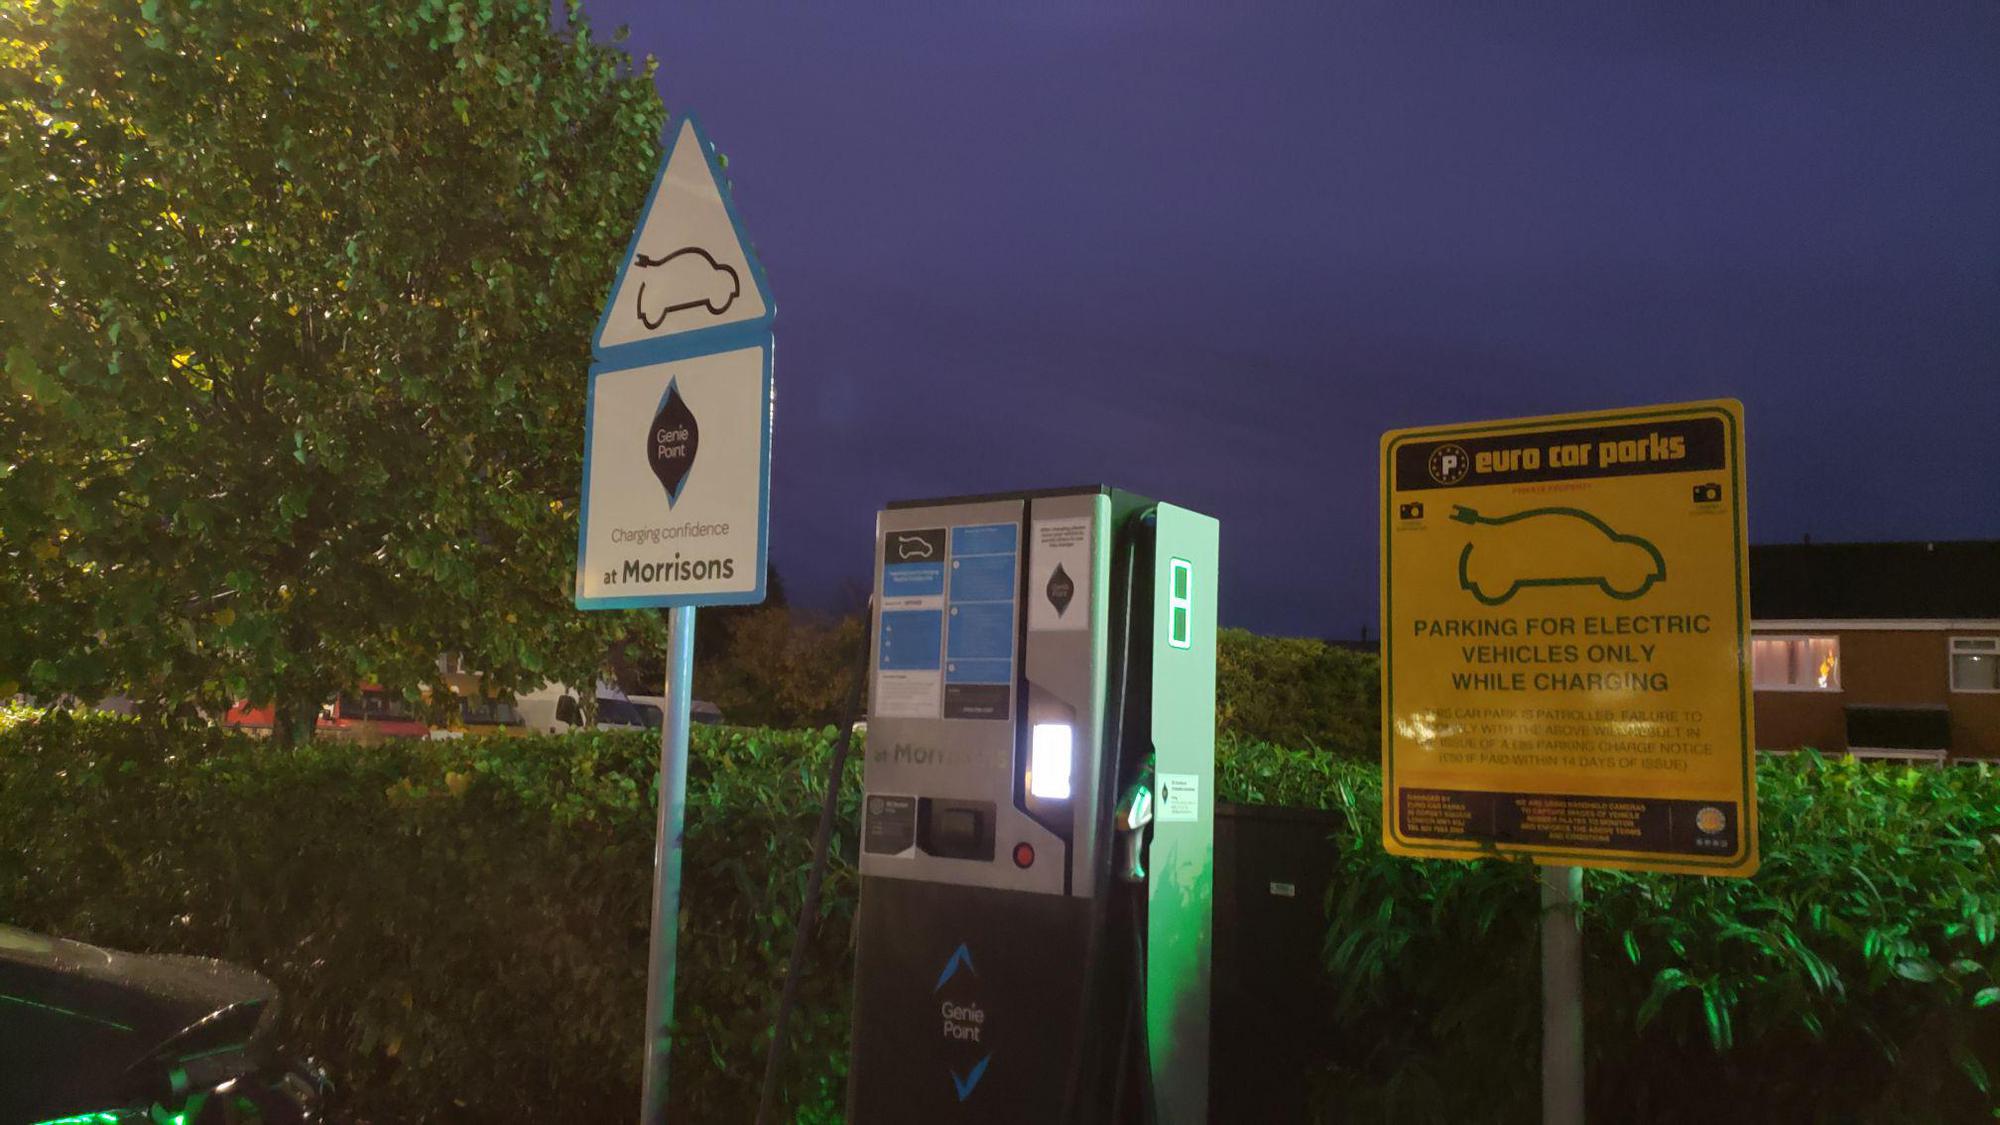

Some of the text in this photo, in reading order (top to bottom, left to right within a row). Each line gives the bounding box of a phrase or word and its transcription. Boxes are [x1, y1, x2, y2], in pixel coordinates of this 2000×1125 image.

[656, 424, 689, 444] Genie
[658, 444, 686, 460] Point
[1474, 447, 1541, 475] euro
[1548, 442, 1592, 468] car
[1599, 432, 1686, 469] parks
[611, 521, 730, 545] Charging confidence
[603, 551, 734, 585] at Morrisons
[1413, 614, 1711, 637] PARKING FOR ELECTRIC
[1461, 643, 1656, 665] VEHICLES ONLY
[1452, 672, 1669, 692] WHILE CHARGING
[1620, 710, 1679, 723] FAILURE
[1684, 711, 1703, 723] TO
[1545, 724, 1589, 737] ABOVE
[1686, 727, 1701, 739] IN
[1536, 740, 1595, 752] PARKING
[1597, 741, 1656, 754] CHARGE
[1660, 742, 1713, 756] NOTICE
[1479, 752, 1510, 766] PAID
[1561, 756, 1576, 767] 14
[1579, 756, 1616, 769] DAYS
[1618, 757, 1637, 769] OF
[941, 1001, 985, 1025] Genie
[943, 1021, 981, 1043] Point
